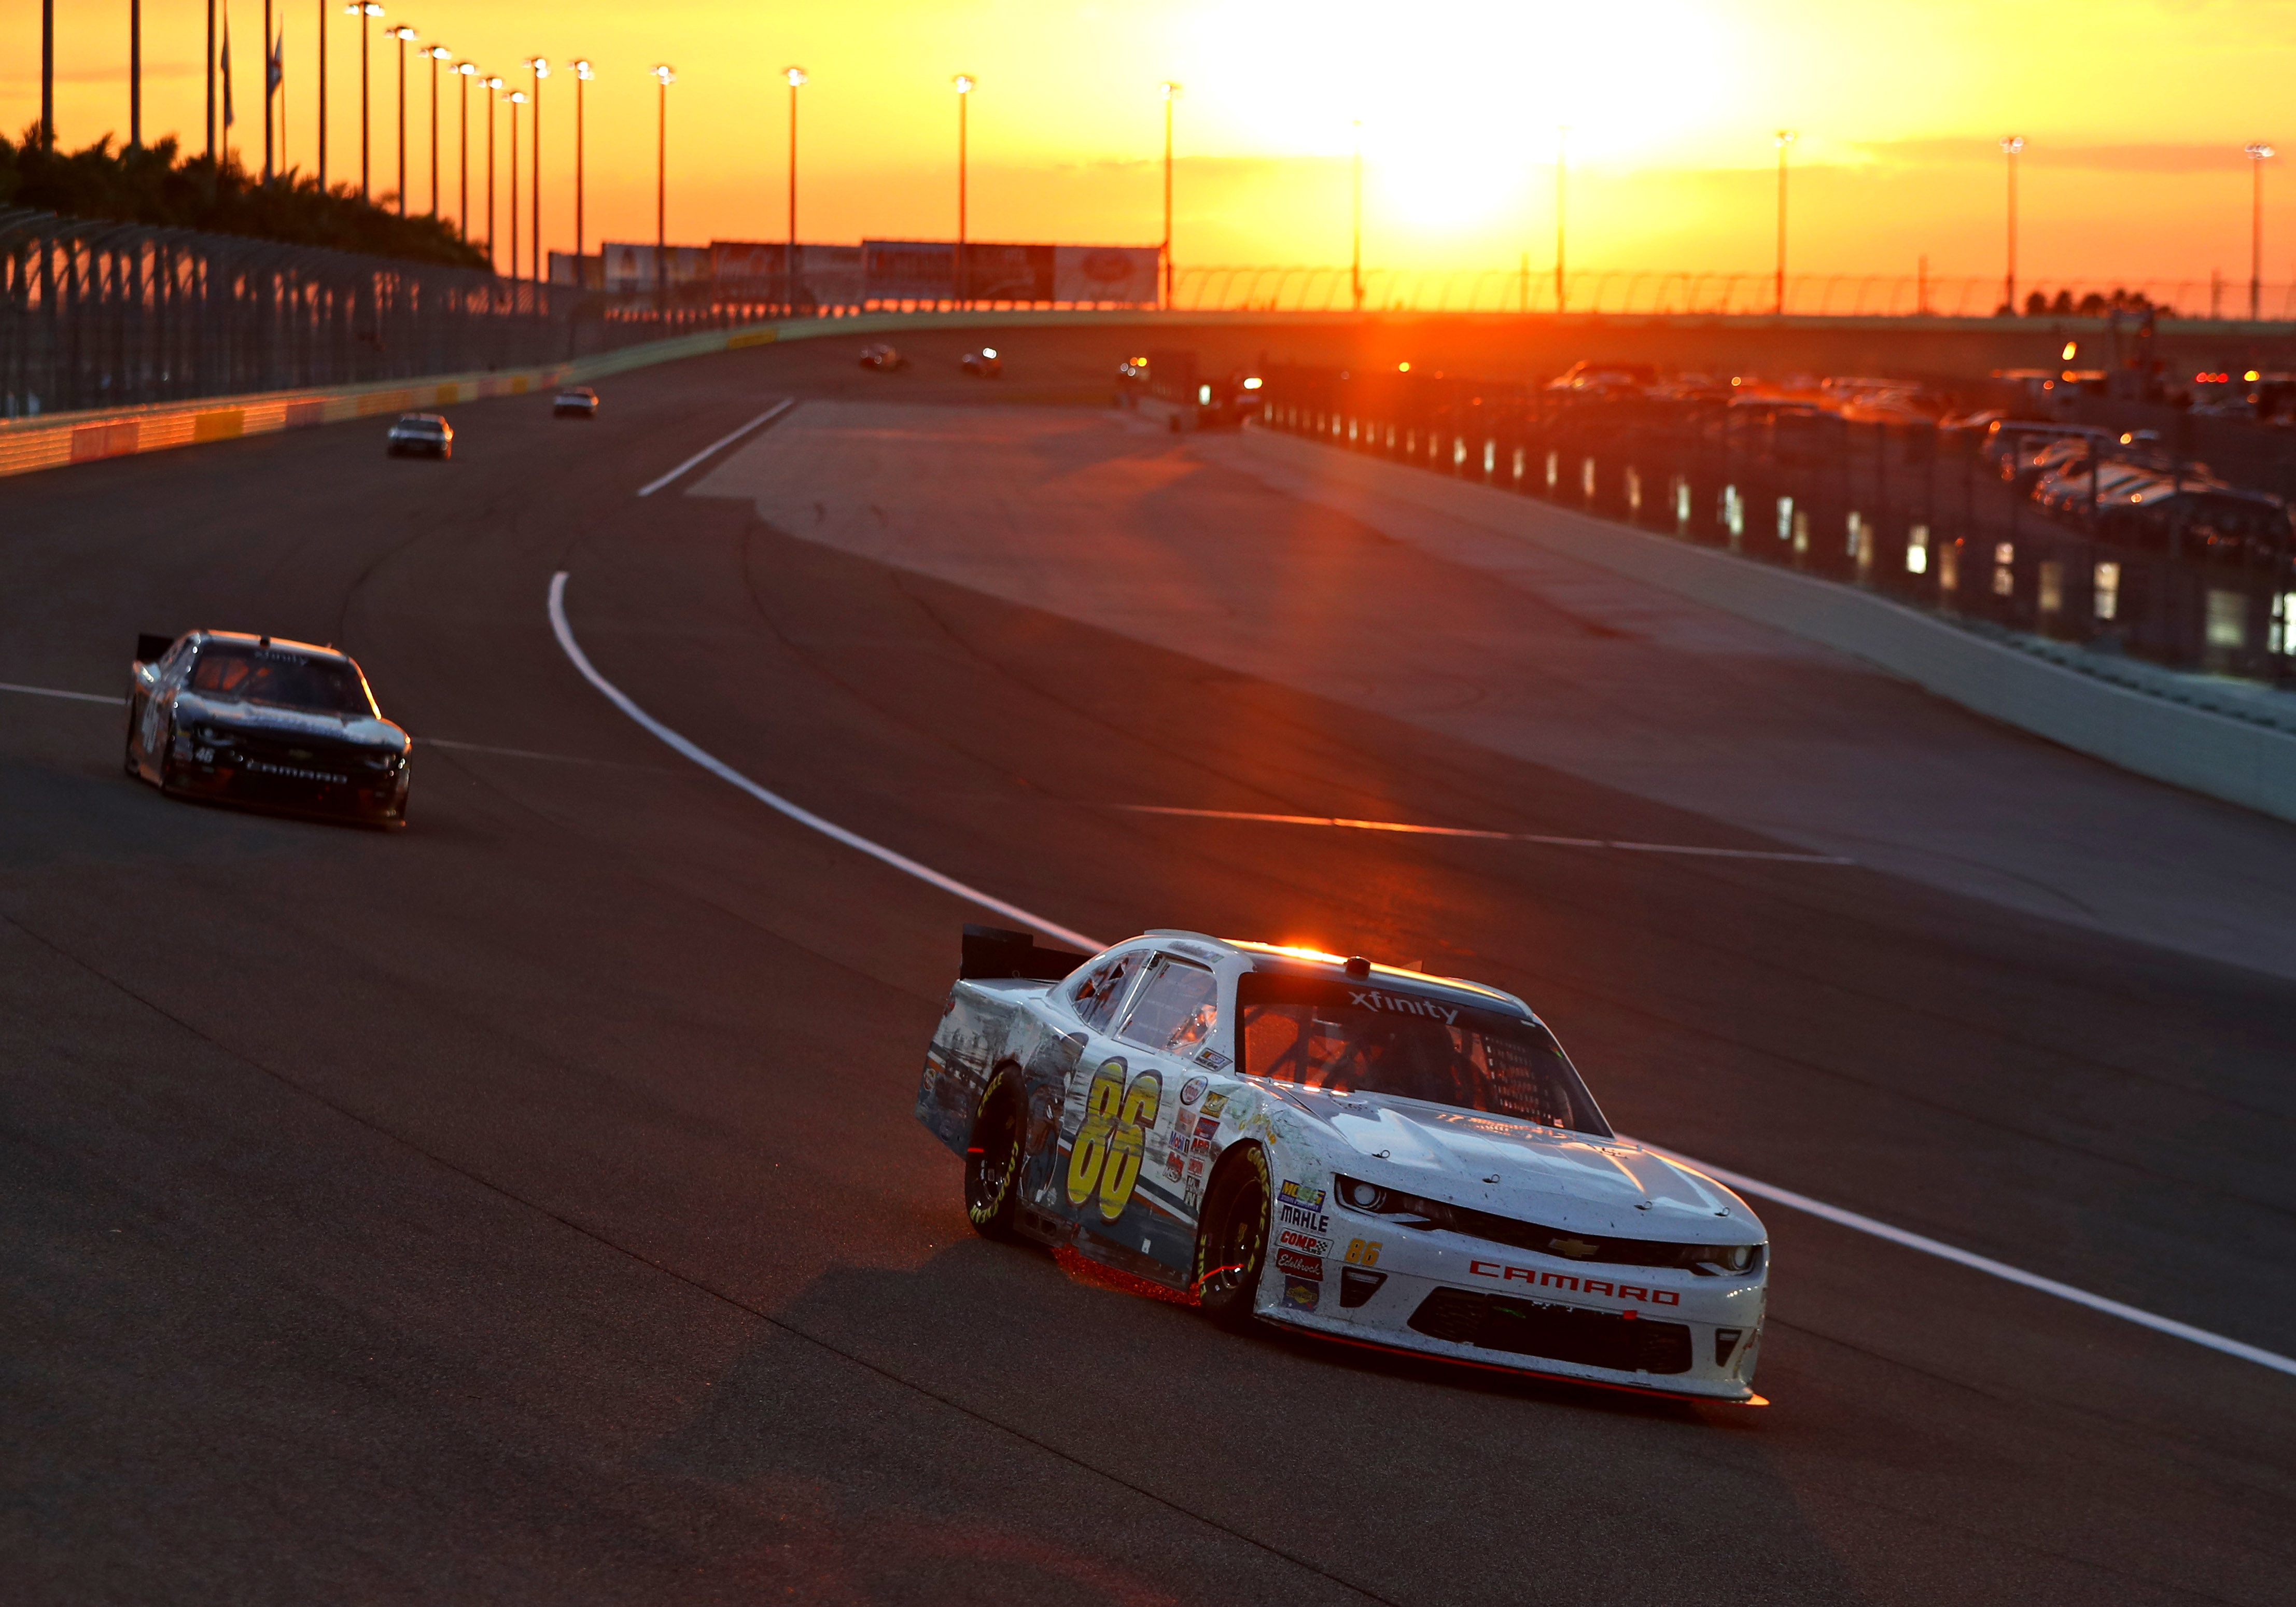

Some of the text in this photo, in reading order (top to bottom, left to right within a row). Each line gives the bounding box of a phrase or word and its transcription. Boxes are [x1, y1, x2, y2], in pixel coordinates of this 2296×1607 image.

[1348, 991, 1458, 1025] xfinity
[1067, 1056, 1163, 1225] 86
[1169, 1130, 1185, 1151] Mobil
[1282, 1181, 1325, 1205] MOG
[1280, 1204, 1329, 1233] MAHLE
[1280, 1231, 1317, 1249] COMP
[1302, 1247, 1323, 1255] CAMS
[1345, 1237, 1383, 1266] 86
[1278, 1253, 1321, 1275] Edelbrock
[1469, 1260, 1679, 1306] CAMARO
